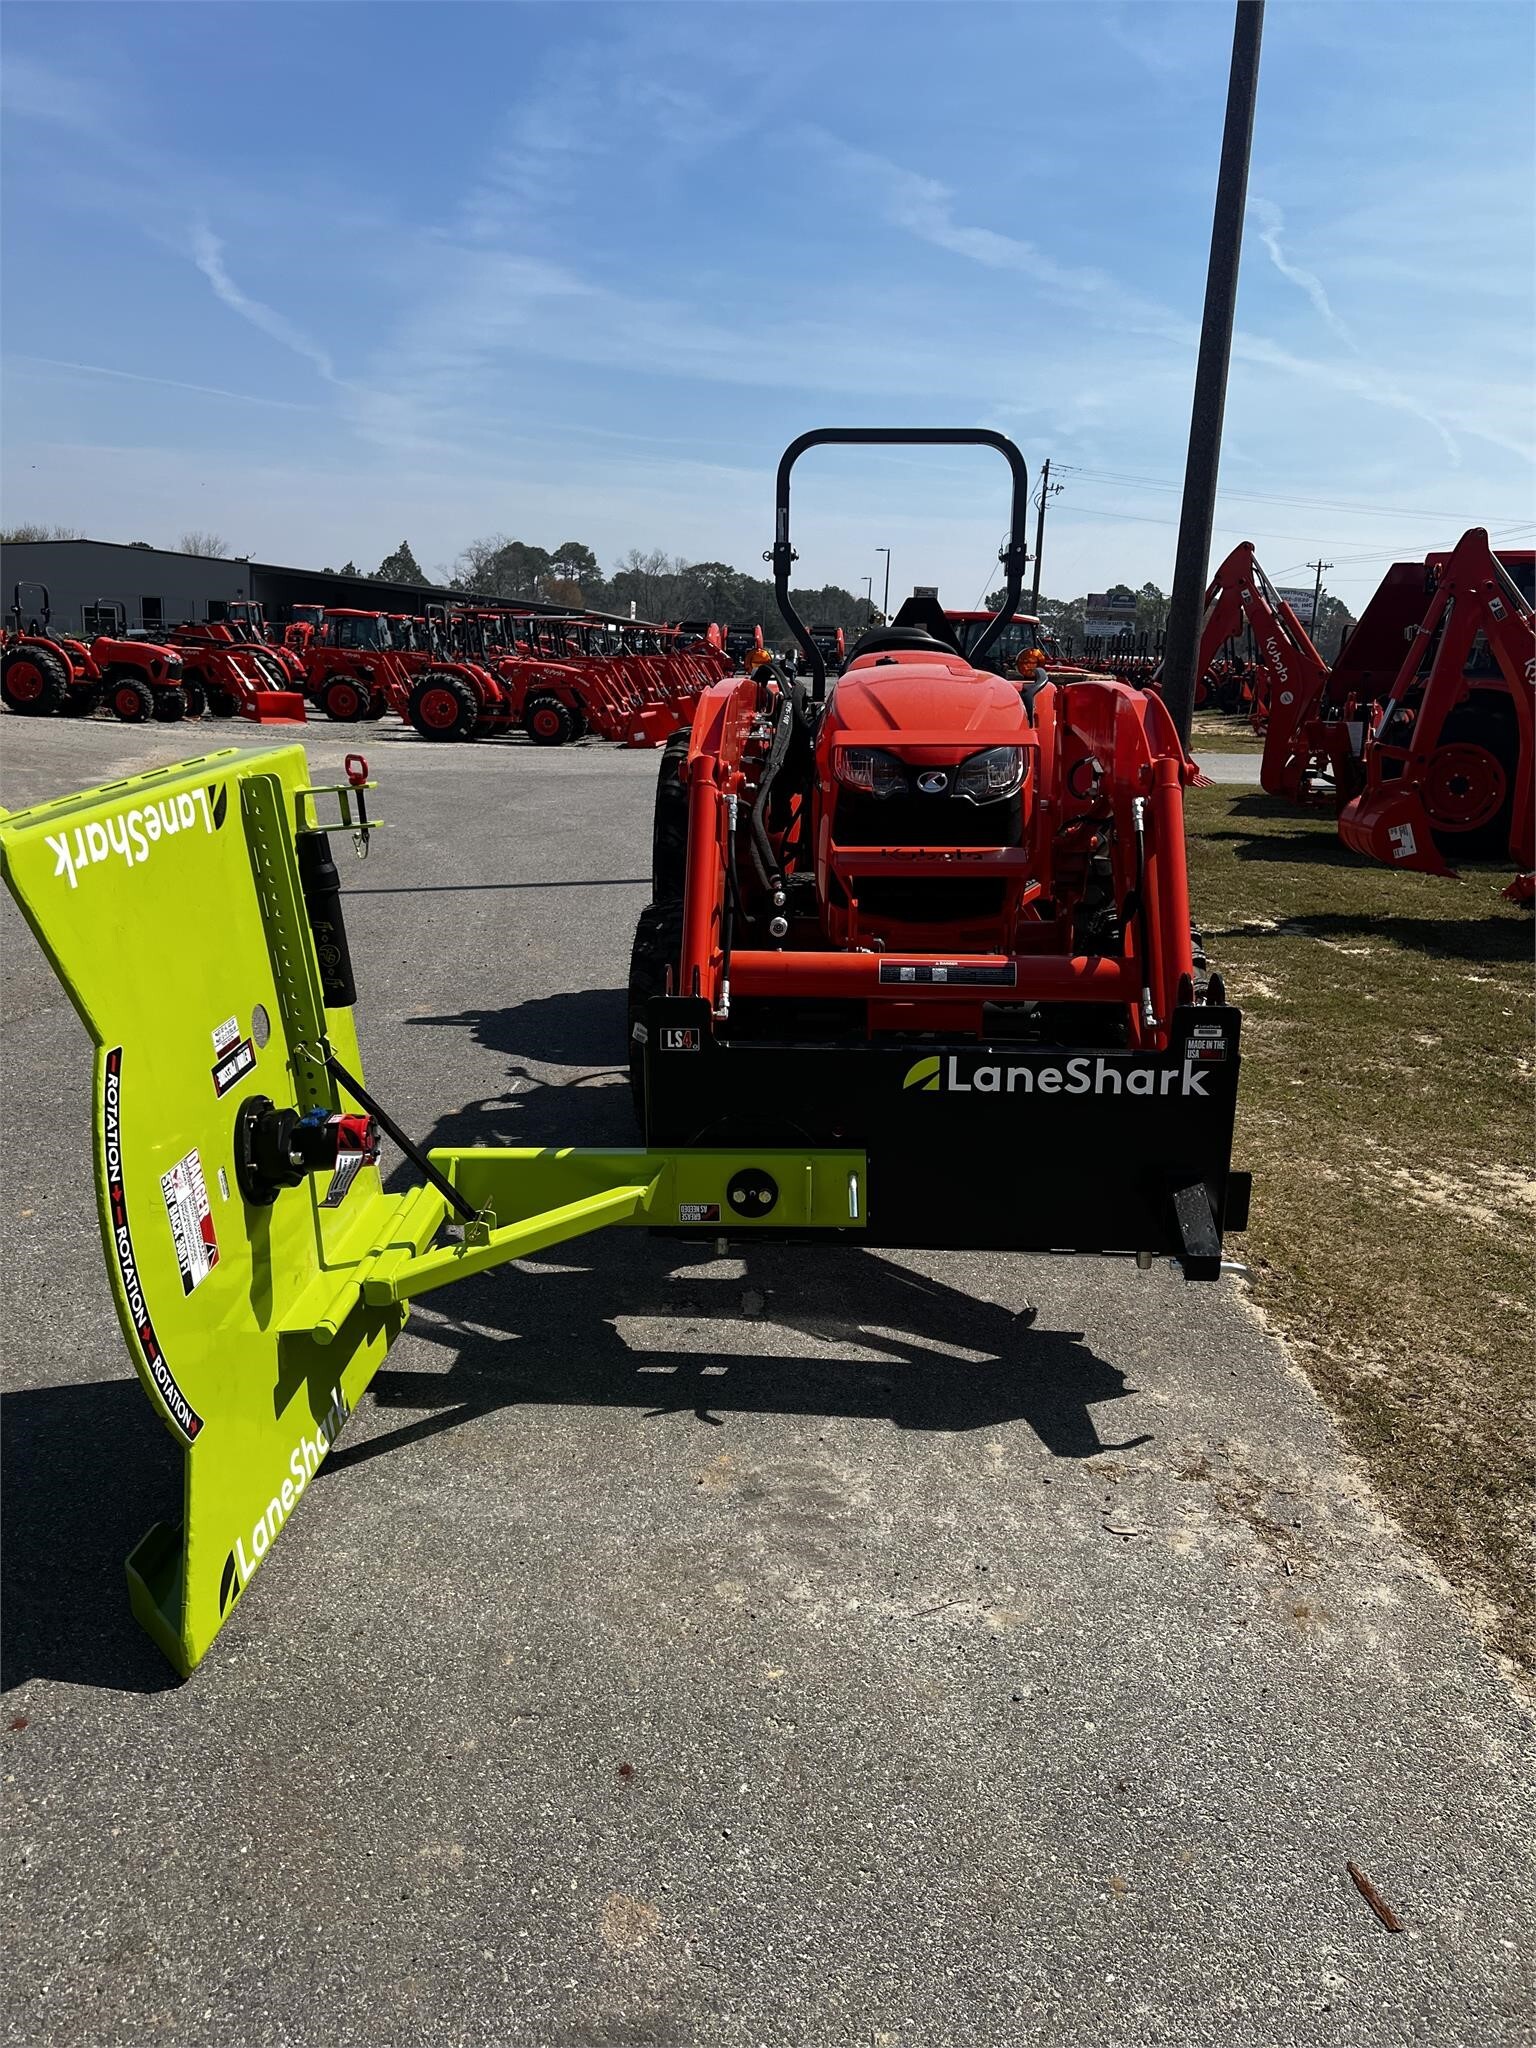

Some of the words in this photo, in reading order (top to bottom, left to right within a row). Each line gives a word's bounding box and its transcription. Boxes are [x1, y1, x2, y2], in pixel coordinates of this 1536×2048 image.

[1266, 636, 1288, 682] Kubota
[45, 787, 213, 889] LaneShark
[667, 1030, 692, 1048] LS4
[1187, 1040, 1205, 1049] MADE
[1206, 1040, 1213, 1049] IN
[1214, 1040, 1225, 1049] THE
[1187, 1050, 1199, 1058] USA
[948, 1056, 1210, 1096] LaneShark
[107, 1073, 121, 1182] ROTATION
[162, 1173, 176, 1205] STAY
[187, 1150, 210, 1222] DANGER
[169, 1205, 181, 1239] BACK
[176, 1236, 188, 1264] 300
[180, 1259, 191, 1276] FT
[117, 1226, 147, 1328] ROTATION
[152, 1353, 193, 1429] ROTATION
[235, 1386, 350, 1582] LaneShark
